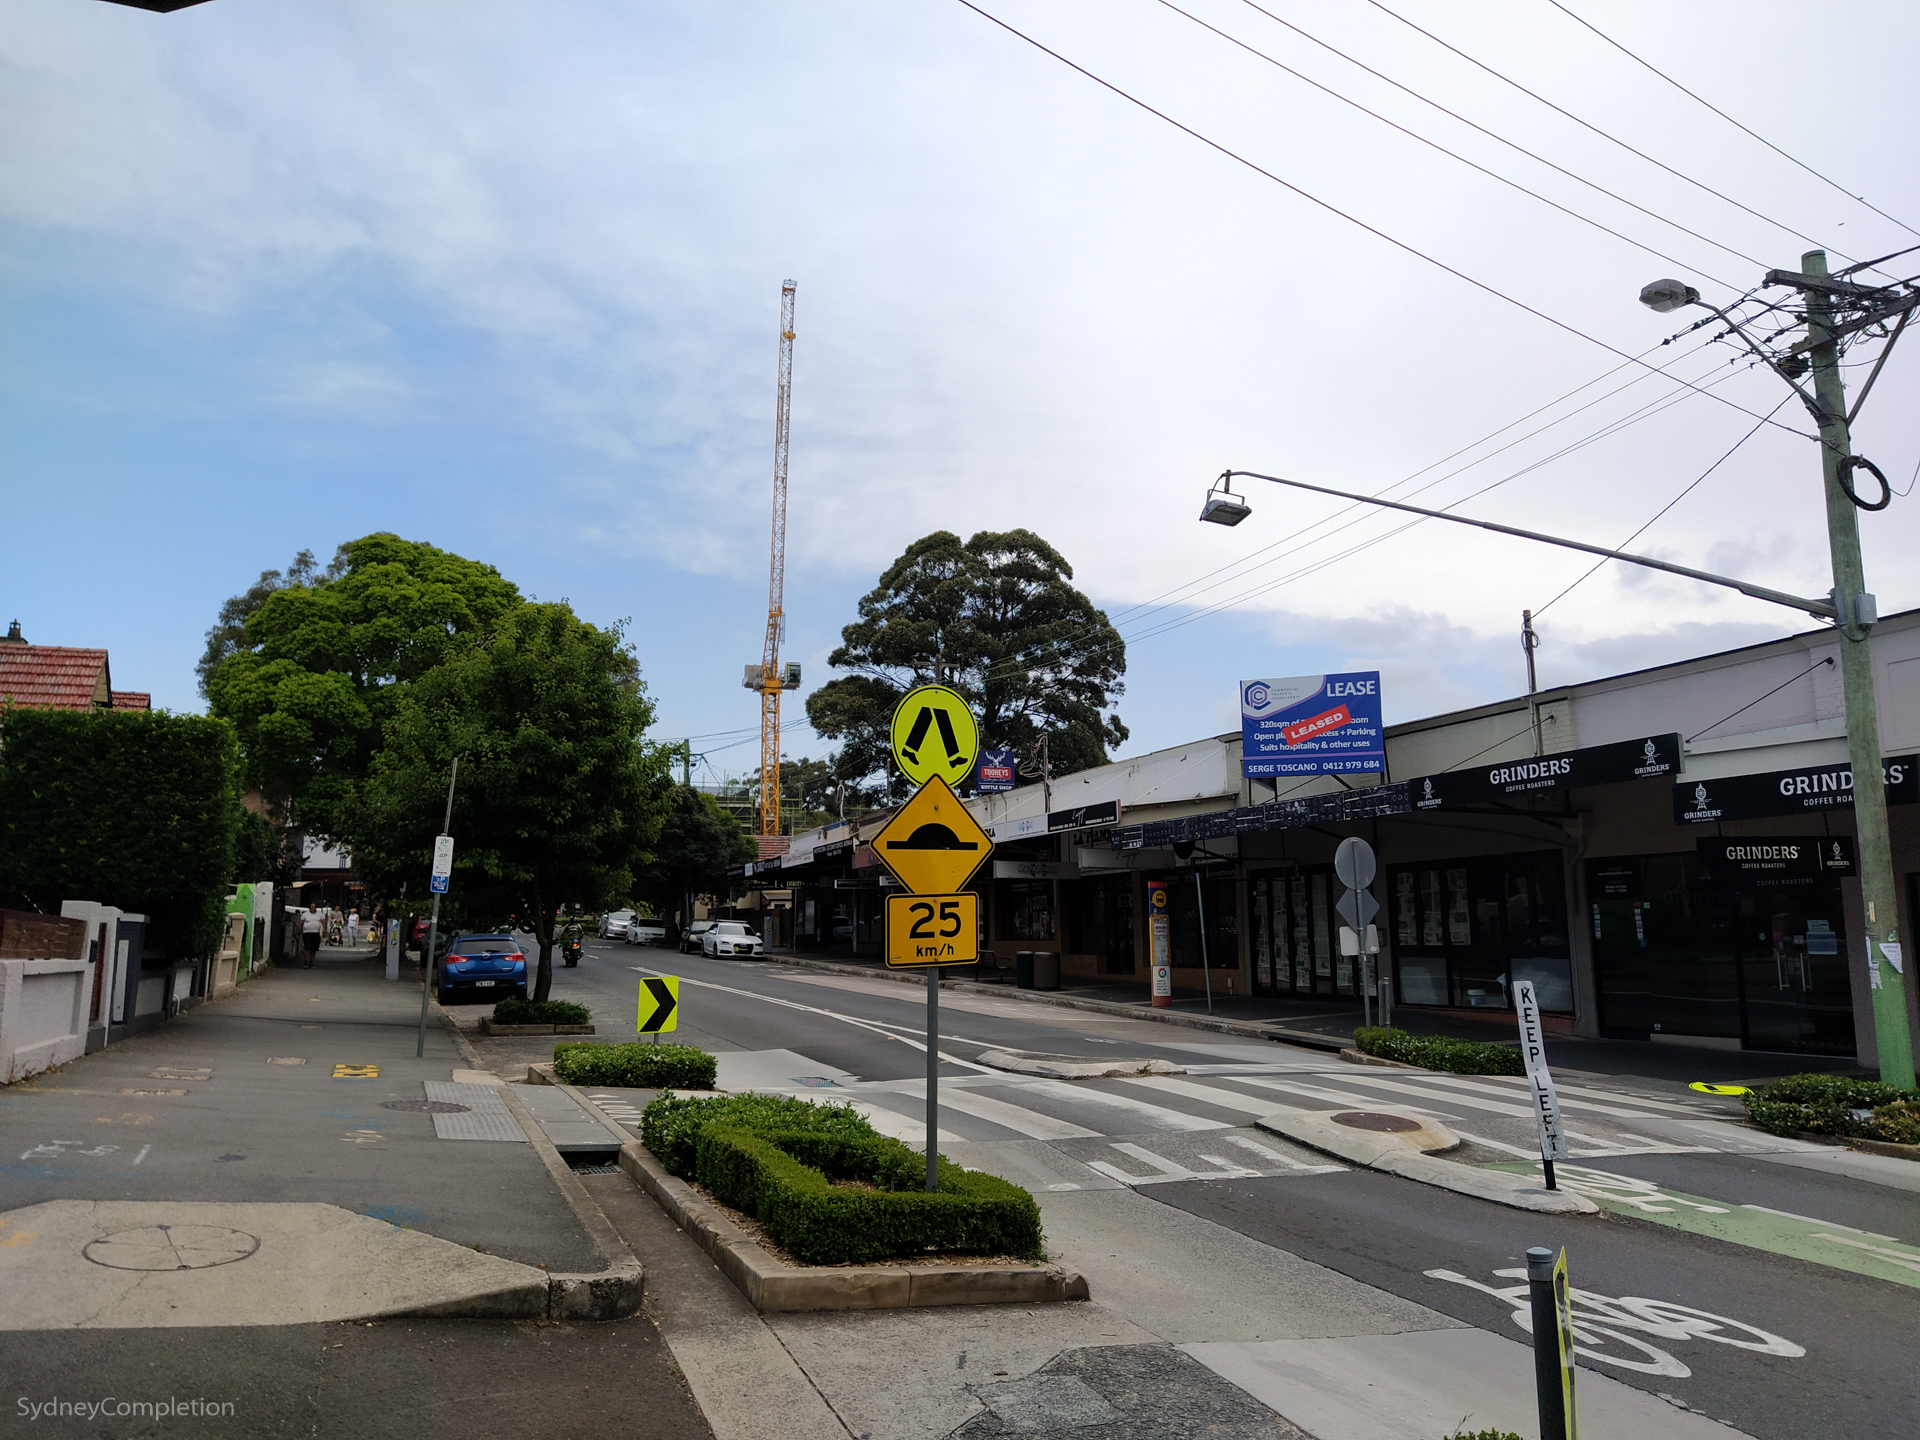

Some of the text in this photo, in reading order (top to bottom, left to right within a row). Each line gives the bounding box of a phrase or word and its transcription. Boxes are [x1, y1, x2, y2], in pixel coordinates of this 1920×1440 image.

[1326, 680, 1376, 698] LEASE
[1260, 720, 1290, 729] 320sqm
[1290, 712, 1343, 739] LEASED
[1254, 732, 1275, 741] Open
[1275, 731, 1287, 741] pla
[1316, 730, 1339, 738] ccess
[1346, 727, 1377, 737] Parking
[1260, 740, 1371, 752] Suits hospitality & other uses
[984, 768, 1009, 777] TOOHEYS
[1248, 760, 1380, 773] SERGE TOSCANO 0412 979 684
[1489, 758, 1571, 785] GRINDERS
[1634, 763, 1669, 775] GRINDERS
[1505, 779, 1556, 792] COFFEE ROASTERS
[1779, 764, 1905, 796] GRINDRS
[1417, 798, 1442, 808] GRINDERS
[1803, 796, 1834, 806] COFFEE
[1683, 809, 1721, 820] GRINDERS
[1725, 845, 1799, 860] GRINDERS
[1756, 877, 1813, 887] COFFEE ROASTERS
[908, 901, 962, 940] 25
[916, 942, 955, 958] km/h
[1520, 988, 1540, 1063] KEEP
[1534, 1075, 1558, 1152] LEFT
